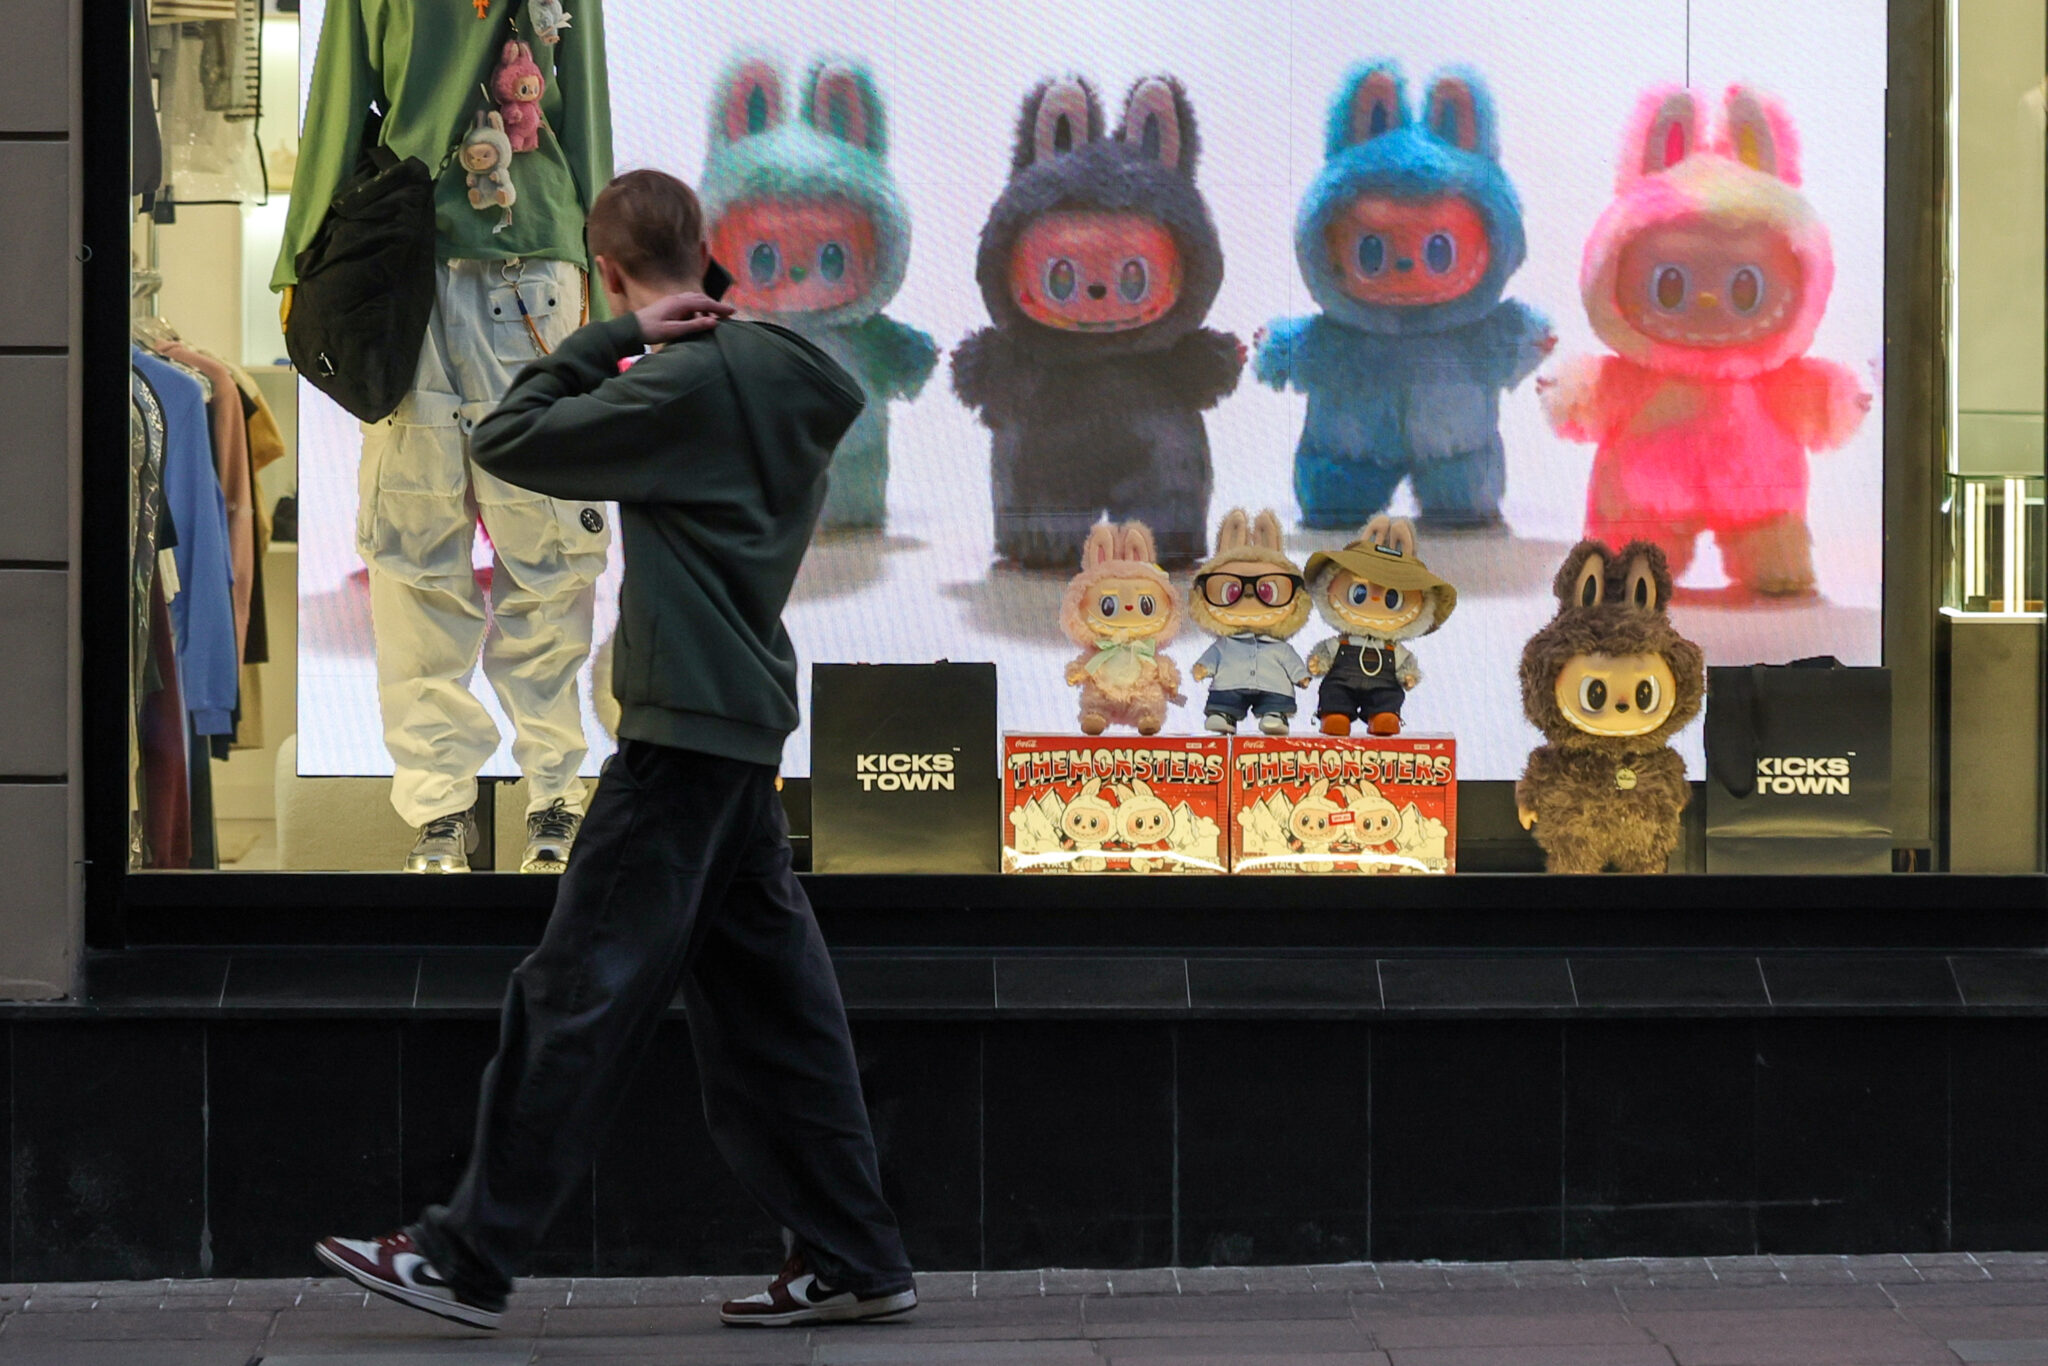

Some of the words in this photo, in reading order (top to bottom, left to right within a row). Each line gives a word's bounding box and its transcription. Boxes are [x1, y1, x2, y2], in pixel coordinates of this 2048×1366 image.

[857, 754, 955, 772] KICKS
[1757, 757, 1850, 776] KICKS
[857, 773, 955, 791] TOWN
[1757, 776, 1850, 795] TOWN
